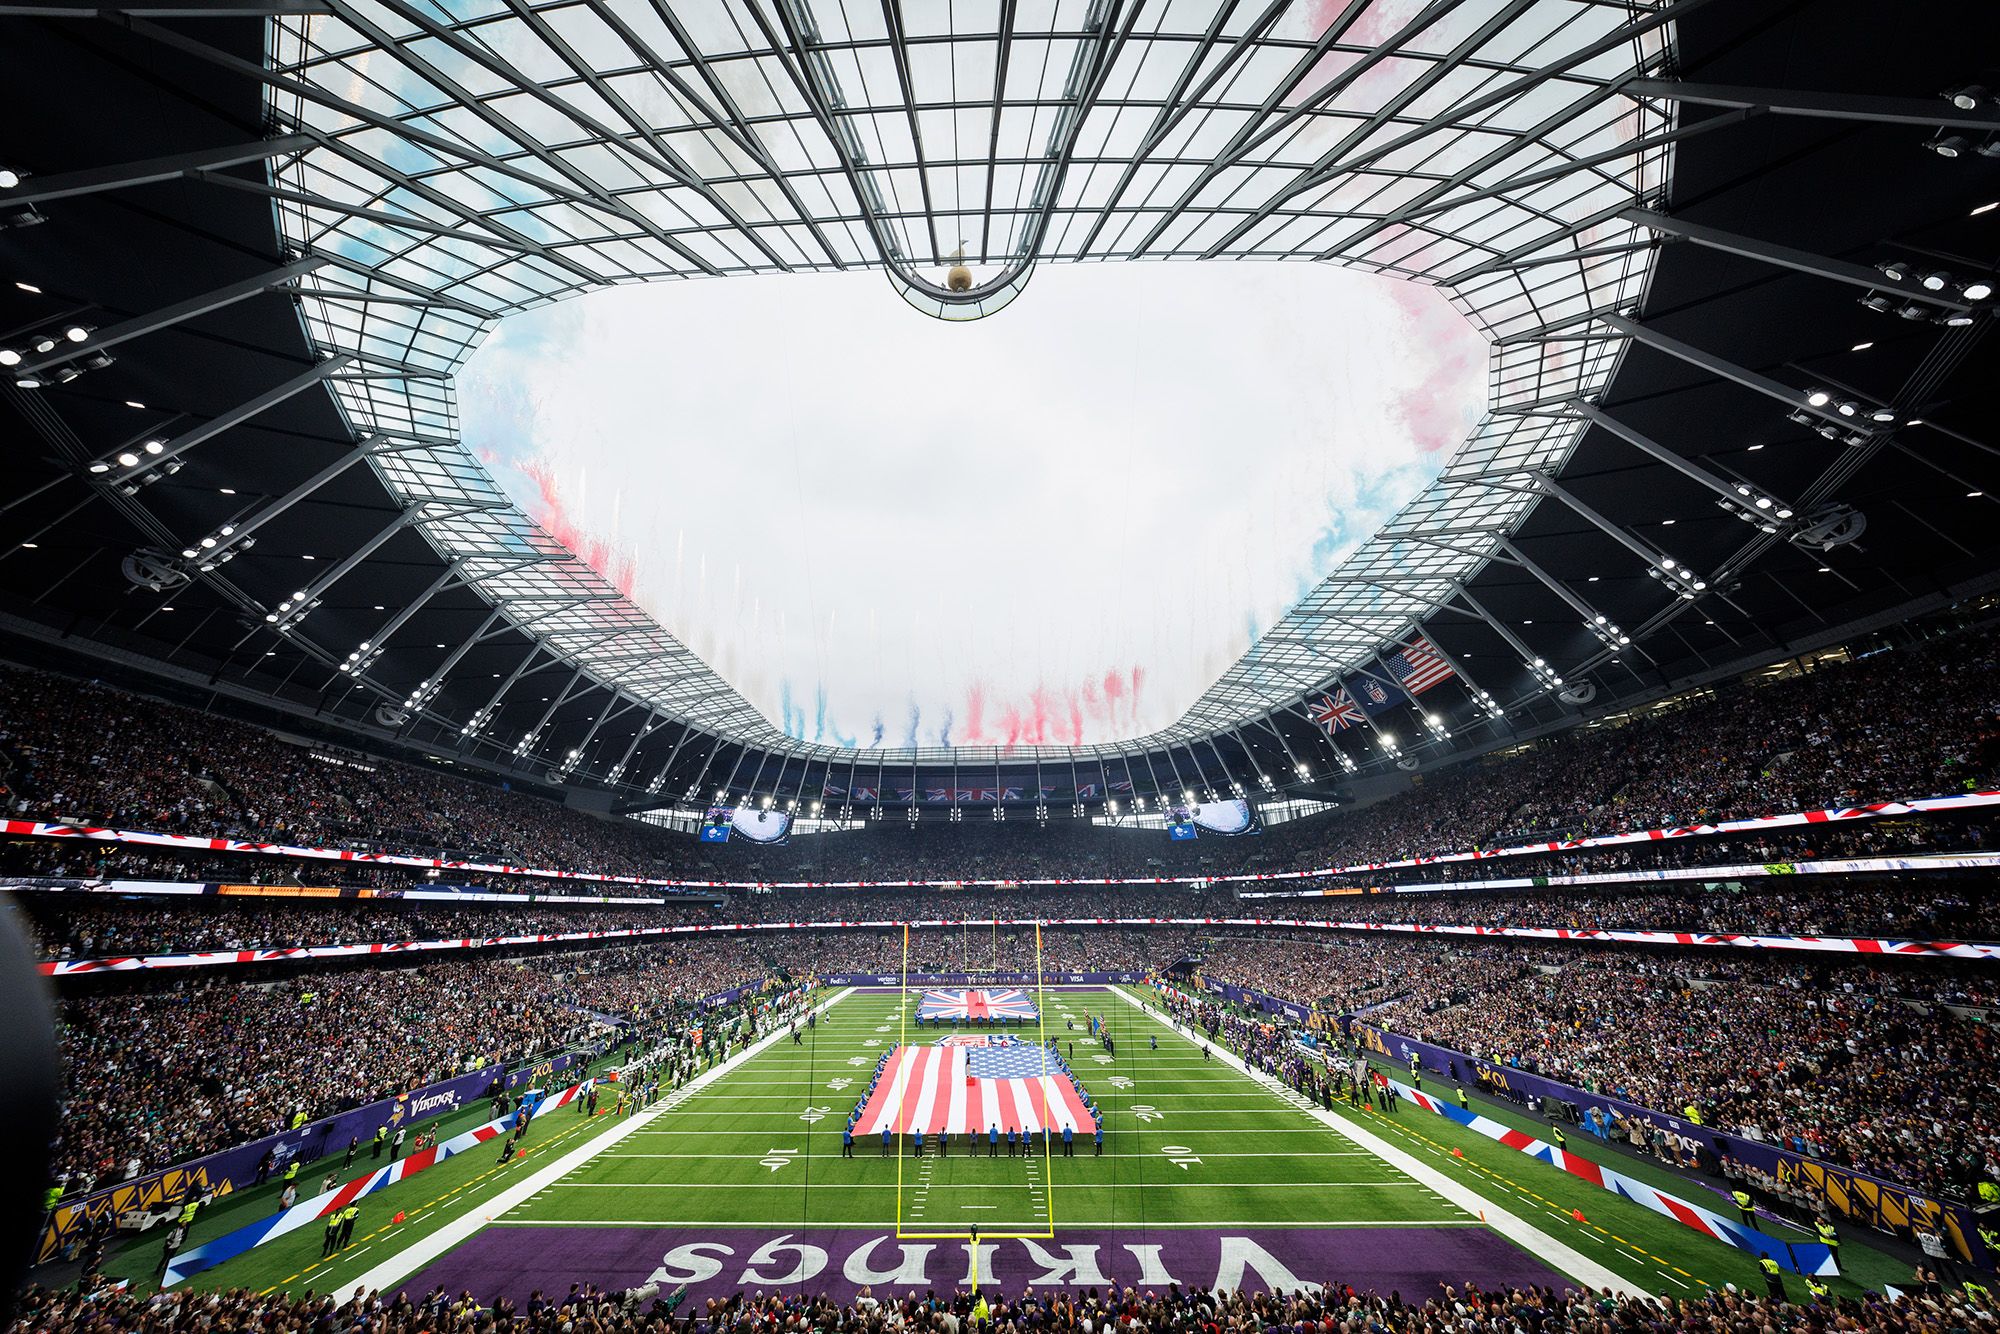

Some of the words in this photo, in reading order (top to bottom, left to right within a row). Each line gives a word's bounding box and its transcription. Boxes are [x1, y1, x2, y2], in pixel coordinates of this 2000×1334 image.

[411, 1091, 455, 1117] VIKINGS
[799, 1106, 832, 1121] 20
[1130, 1105, 1165, 1120] 20
[759, 1147, 799, 1166] 10
[1161, 1145, 1203, 1165] 10
[72, 1203, 85, 1212] 101
[634, 1233, 1323, 1300] VIKINGS
